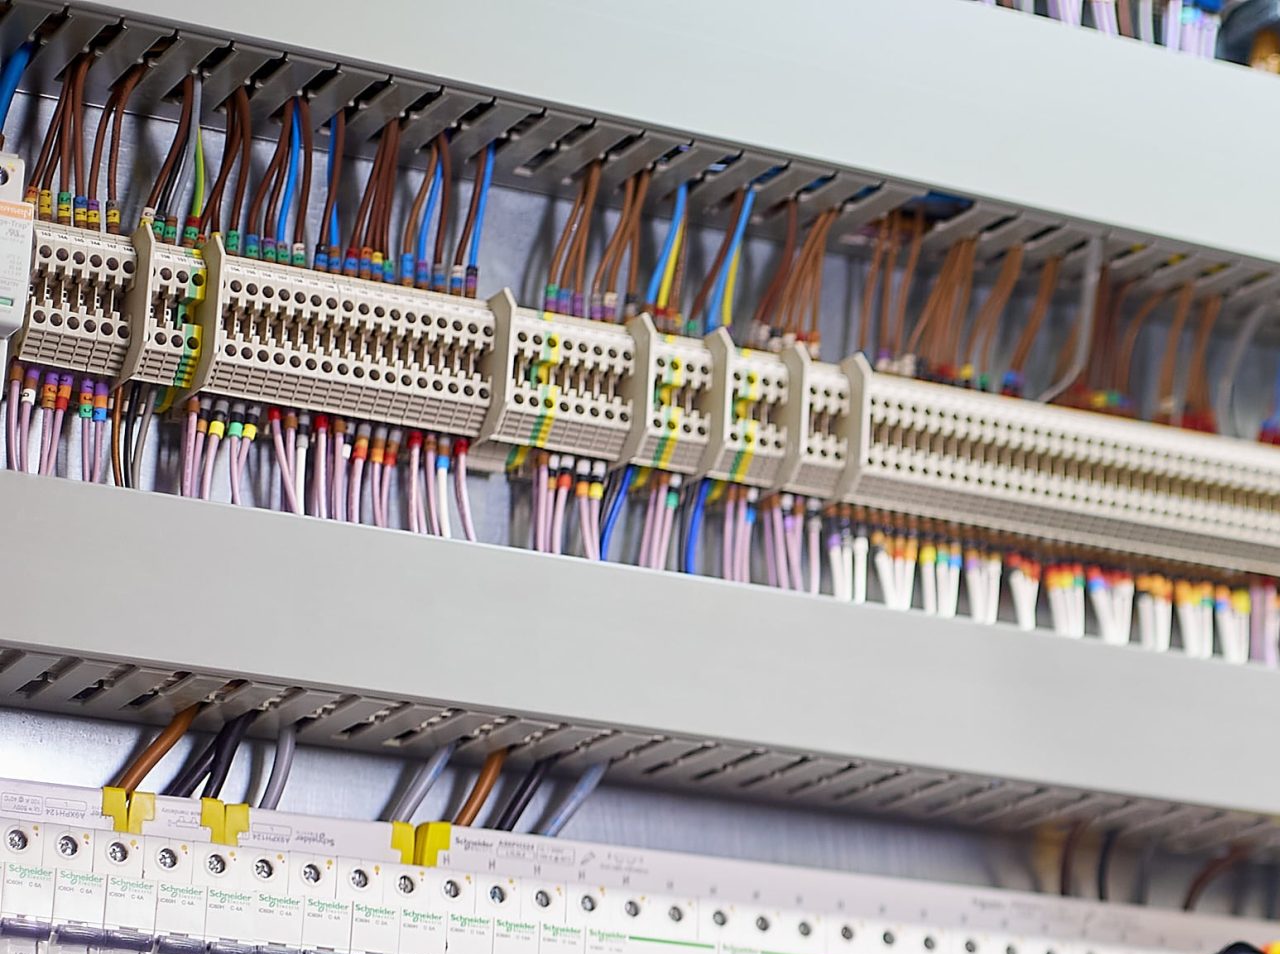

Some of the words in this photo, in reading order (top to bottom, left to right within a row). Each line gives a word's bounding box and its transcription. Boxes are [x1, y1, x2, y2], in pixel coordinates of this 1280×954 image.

[46, 809, 85, 819] A9XPH124
[295, 833, 335, 846] Schneider
[9, 864, 52, 879] Schneider
[60, 870, 104, 885] Schneider
[110, 877, 154, 892] Schneider
[160, 884, 203, 898] Schneider
[209, 889, 252, 903] Schneider
[259, 894, 300, 908] Schneider
[308, 898, 349, 912] Schneider
[355, 904, 396, 917] Schneider
[403, 909, 443, 922] Schneider
[450, 914, 490, 927] Schneider
[496, 920, 536, 932] Schneider
[543, 924, 582, 936] Schneider
